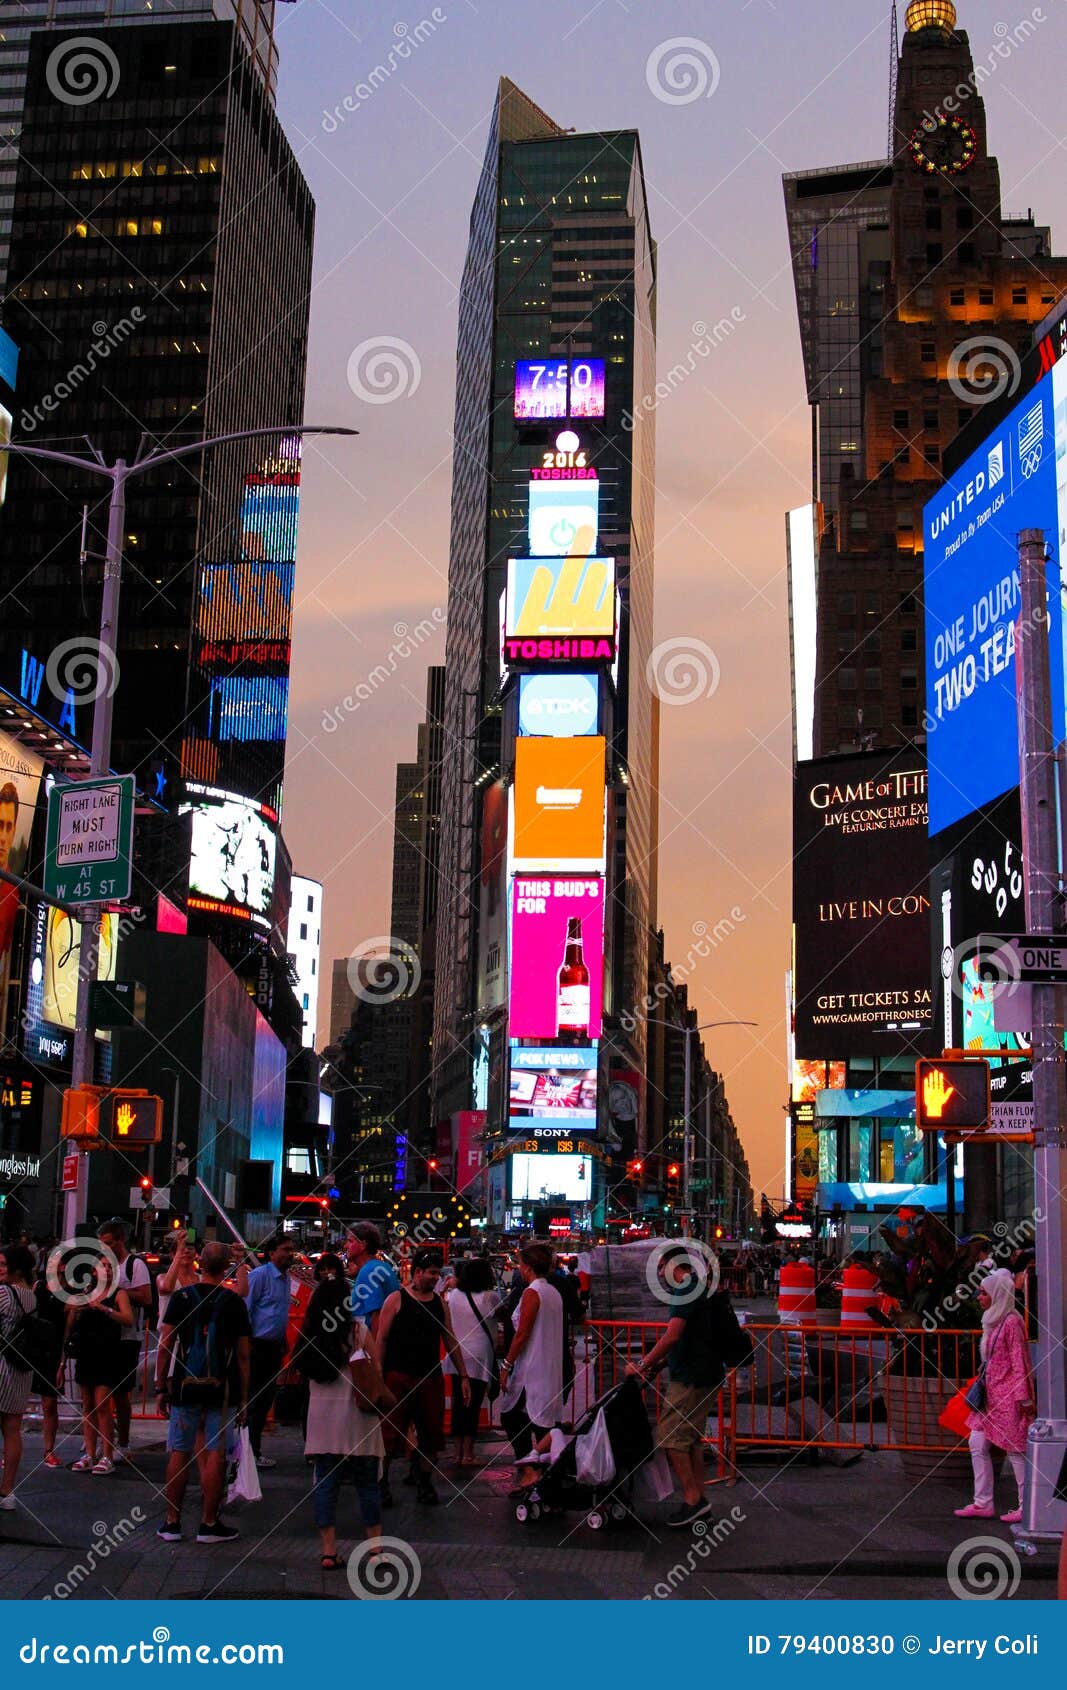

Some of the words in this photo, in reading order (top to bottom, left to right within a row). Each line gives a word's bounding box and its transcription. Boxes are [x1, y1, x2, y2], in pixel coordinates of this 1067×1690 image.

[528, 365, 592, 390] 7:50
[543, 452, 587, 468] 2016
[532, 468, 598, 479] TOSHIBA
[931, 472, 985, 540] UNITED
[945, 533, 960, 560] Proud
[976, 507, 991, 529] Team
[992, 492, 1005, 515] USA
[934, 616, 966, 670] ONE
[969, 570, 1022, 642] JOURN
[506, 640, 612, 658] TOSHIBA
[934, 654, 976, 719] TWO
[540, 698, 592, 715] TDK
[810, 781, 874, 808] GAME
[64, 799, 89, 812] RIGHT
[93, 795, 116, 808] LANE
[825, 812, 849, 826] LIVE
[851, 805, 907, 822] CONCERT
[73, 817, 105, 834] MUST
[842, 820, 887, 833] FEATURING
[889, 817, 919, 829] RAMIN
[59, 843, 83, 856] TURN
[88, 839, 116, 853] RIGHT
[80, 866, 93, 878] AT
[56, 884, 66, 899] W
[73, 882, 91, 897] 45
[100, 879, 116, 894] ST
[517, 881, 551, 897] THIS
[553, 881, 599, 897] BUD'S
[219, 905, 232, 914] BUT
[517, 897, 546, 914] FOR
[820, 901, 857, 921] LIVE
[862, 899, 882, 918] IN
[1023, 951, 1062, 968] ONE
[817, 995, 845, 1009] GET
[849, 991, 909, 1007] TICKETS
[913, 989, 931, 1003] SA
[520, 1053, 544, 1065] FOX
[545, 1053, 580, 1065] NEWS
[1008, 1119, 1027, 1129] KEEP
[534, 1129, 571, 1137] SONY
[557, 1140, 573, 1153] ISIS
[27, 1156, 40, 1177] hut
